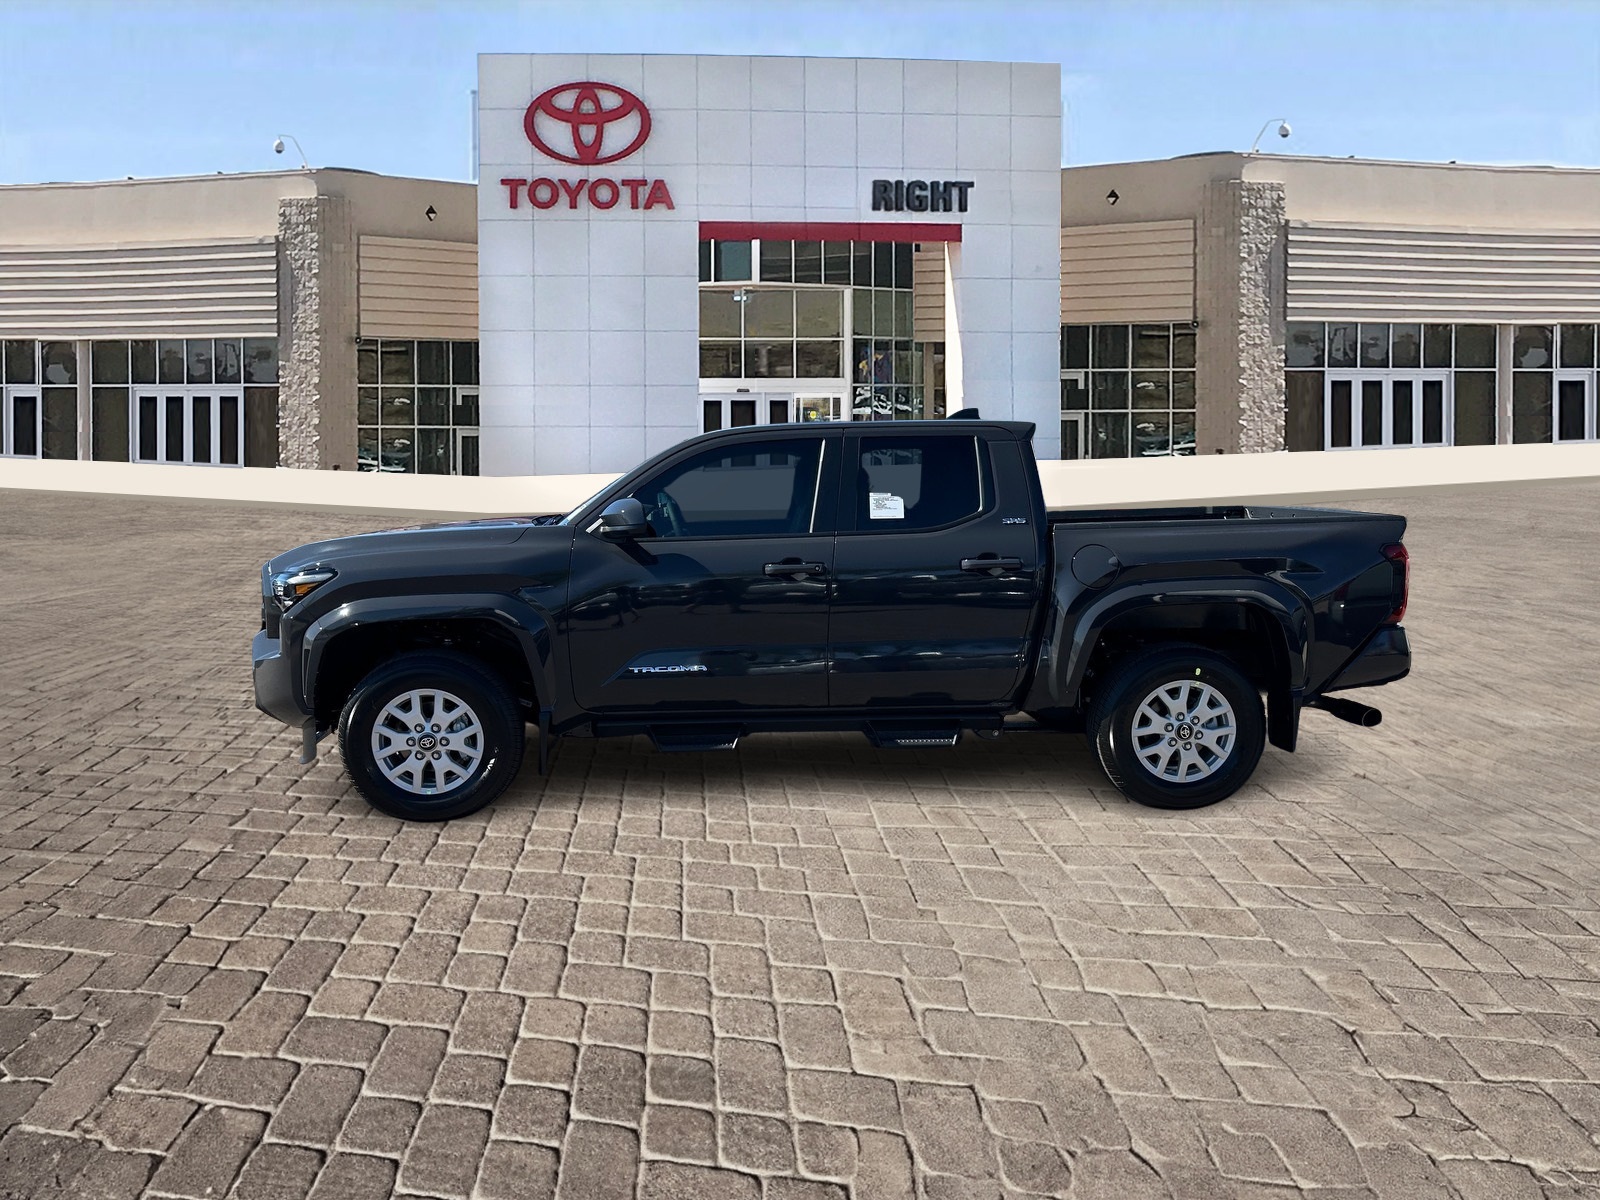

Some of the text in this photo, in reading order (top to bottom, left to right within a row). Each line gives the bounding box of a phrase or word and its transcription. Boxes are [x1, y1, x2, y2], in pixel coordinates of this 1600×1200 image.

[500, 178, 675, 210] TOYOTA
[872, 179, 975, 212] RIGHT
[628, 664, 708, 673] TACOMA
